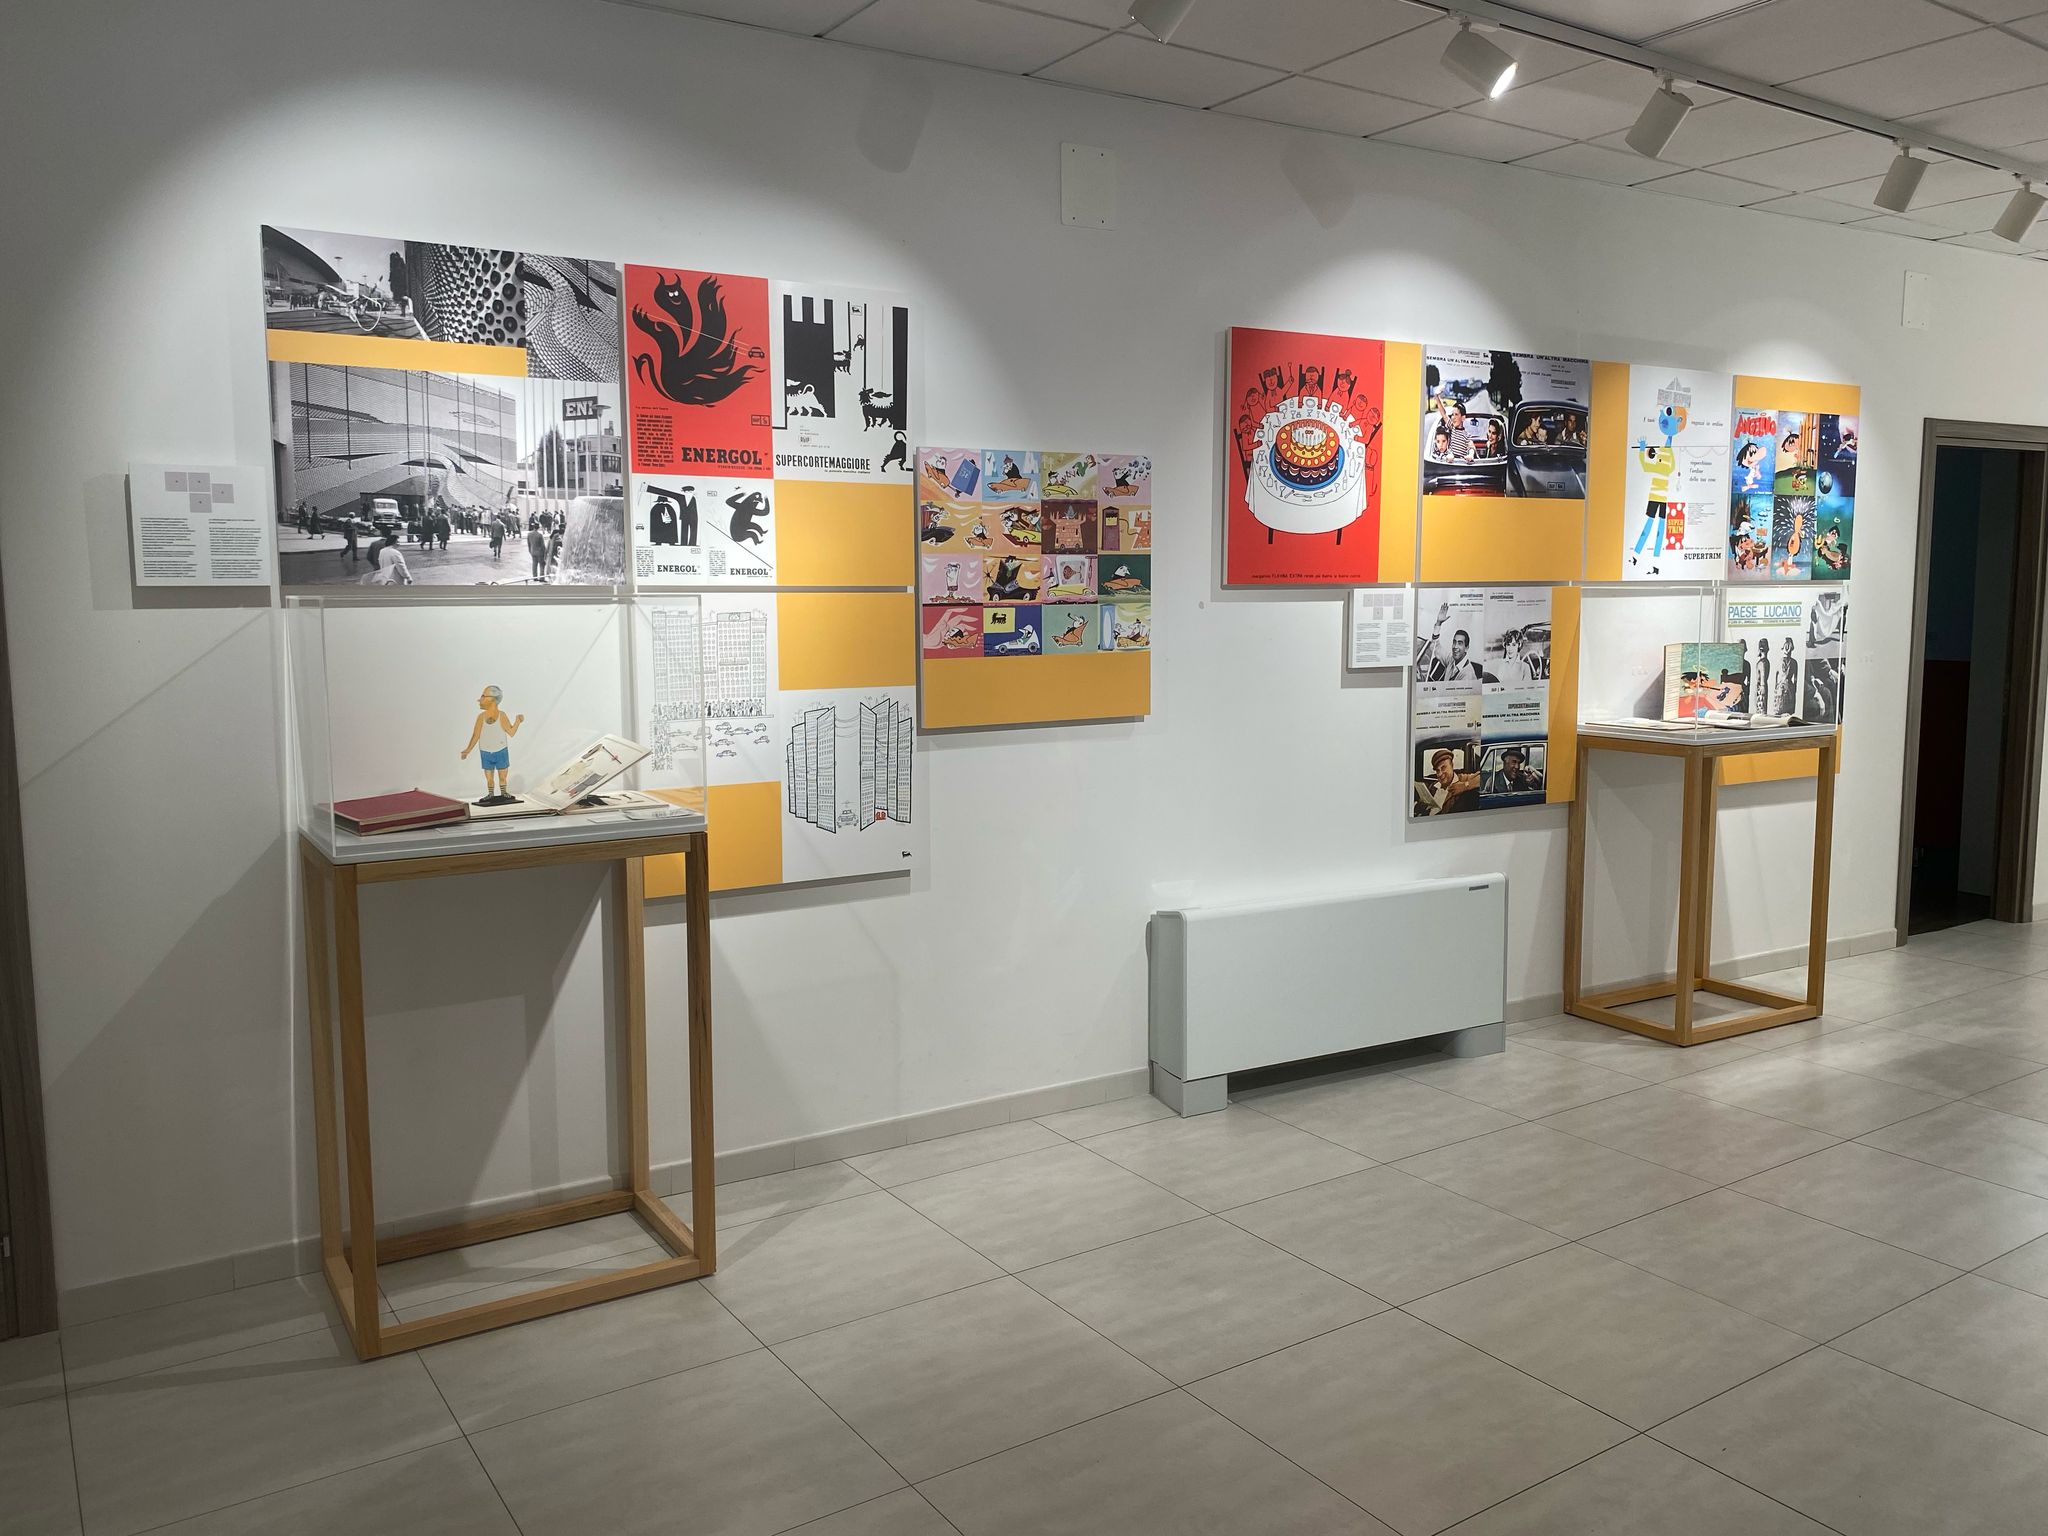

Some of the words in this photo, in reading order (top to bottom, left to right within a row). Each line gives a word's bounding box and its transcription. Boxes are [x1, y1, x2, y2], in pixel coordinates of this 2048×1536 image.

[565, 400, 594, 417] ENI
[681, 447, 763, 466] ENERGOL
[776, 454, 871, 471] SUPERCORTEMAGGIORE
[657, 565, 697, 573] ENERGOL
[730, 568, 769, 576] ENERGOL
[1728, 606, 1757, 618] PAESE
[1764, 605, 1802, 617] LUCANO
